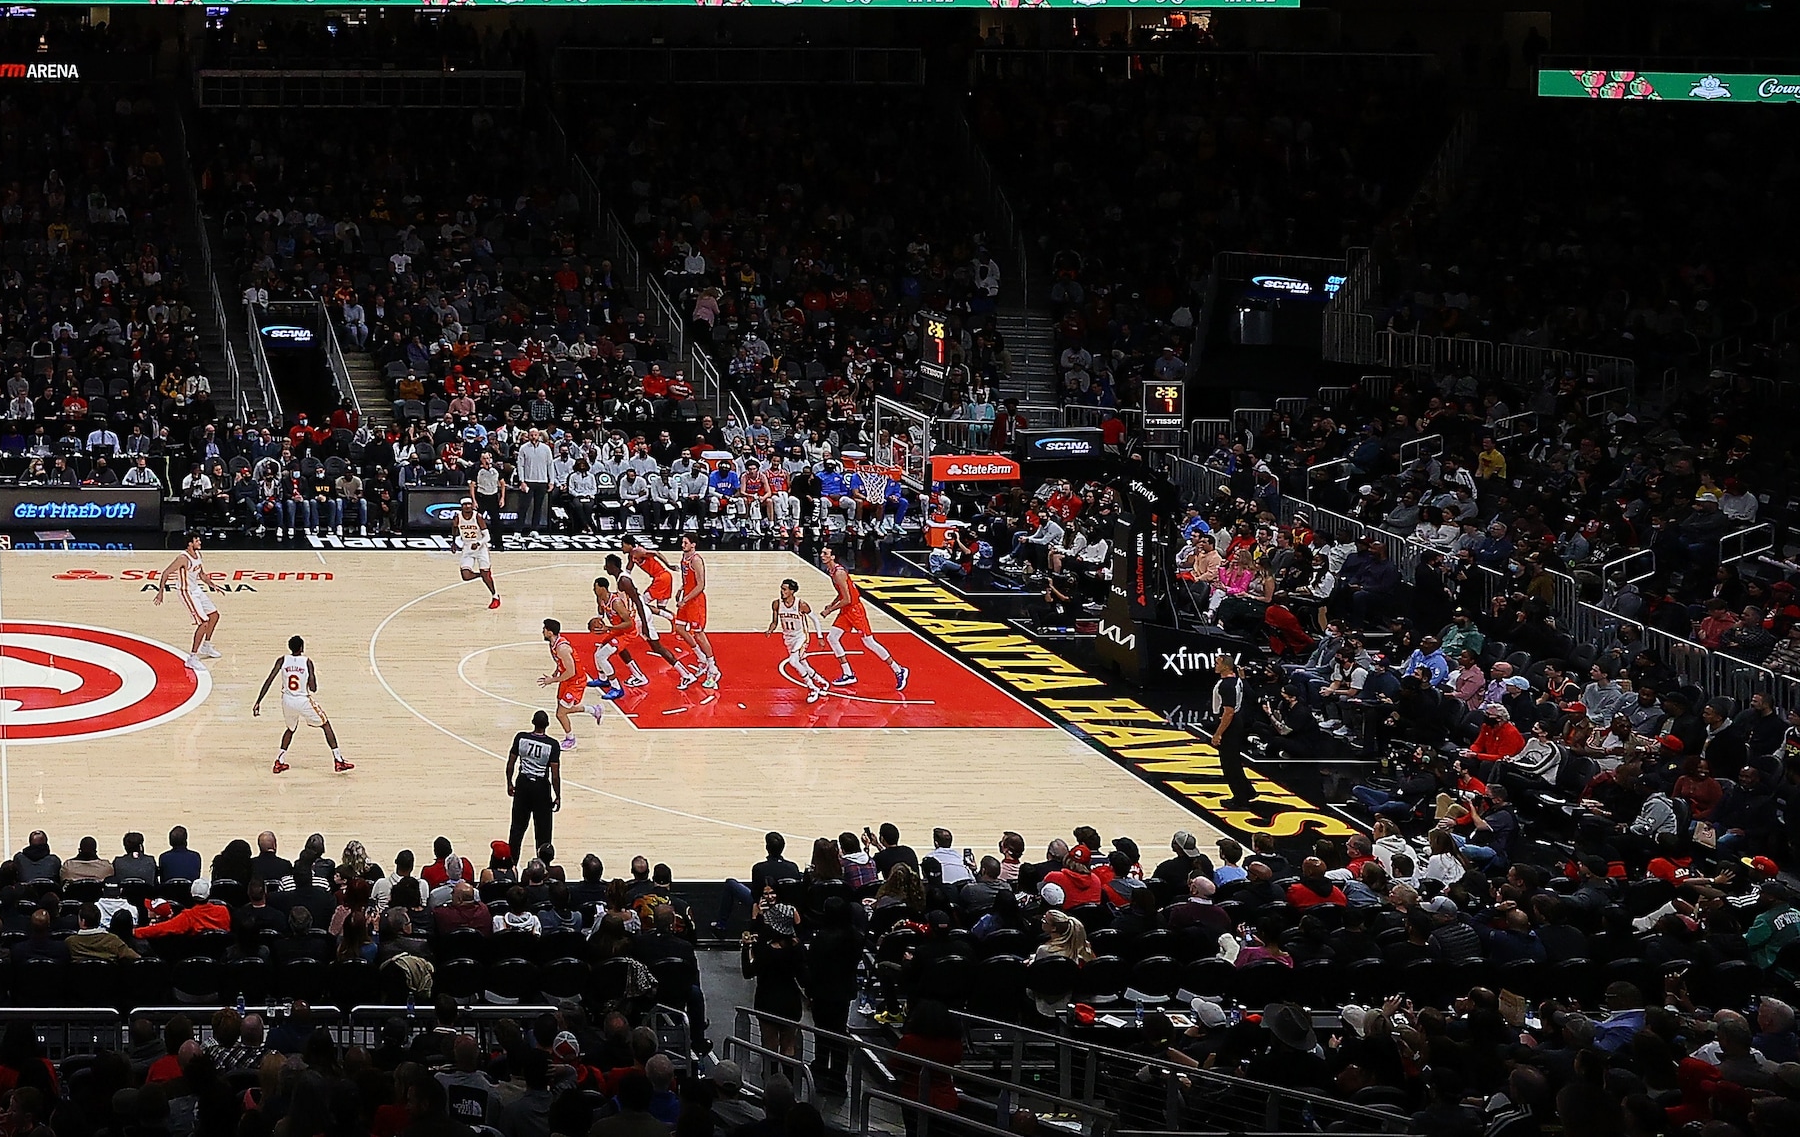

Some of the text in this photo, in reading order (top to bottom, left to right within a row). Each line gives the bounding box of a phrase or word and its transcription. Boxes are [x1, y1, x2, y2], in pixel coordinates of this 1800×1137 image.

[26, 63, 79, 79] ARENA
[1155, 387, 1178, 399] 2:36
[1046, 442, 1089, 451] SCANA
[1129, 479, 1158, 503] xfinity
[15, 503, 136, 520] GET FIRED UP!
[232, 570, 334, 581] Farm
[784, 622, 795, 631] 11
[850, 574, 1107, 691] ATLANTA
[288, 674, 300, 691] 6
[528, 743, 542, 759] 70
